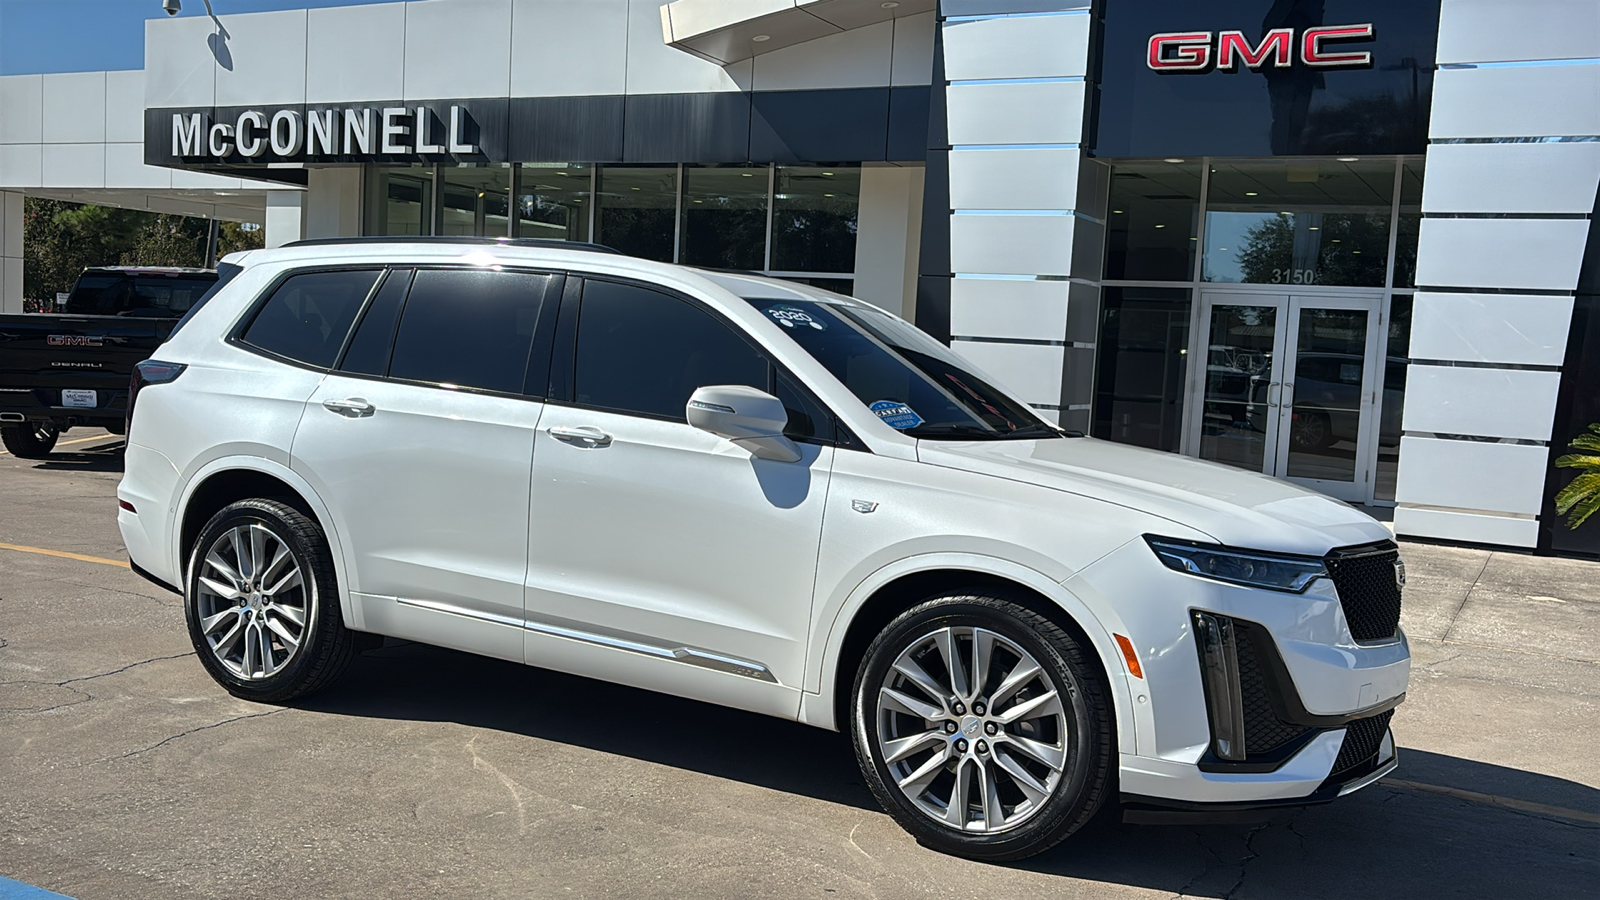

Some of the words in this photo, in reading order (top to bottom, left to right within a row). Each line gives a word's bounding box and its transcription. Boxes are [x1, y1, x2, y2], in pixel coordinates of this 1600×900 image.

[1146, 23, 1373, 71] GMC
[171, 105, 476, 157] McCONNELL
[1271, 268, 1315, 284] 3150
[768, 309, 813, 322] 2020
[47, 334, 103, 346] GMC
